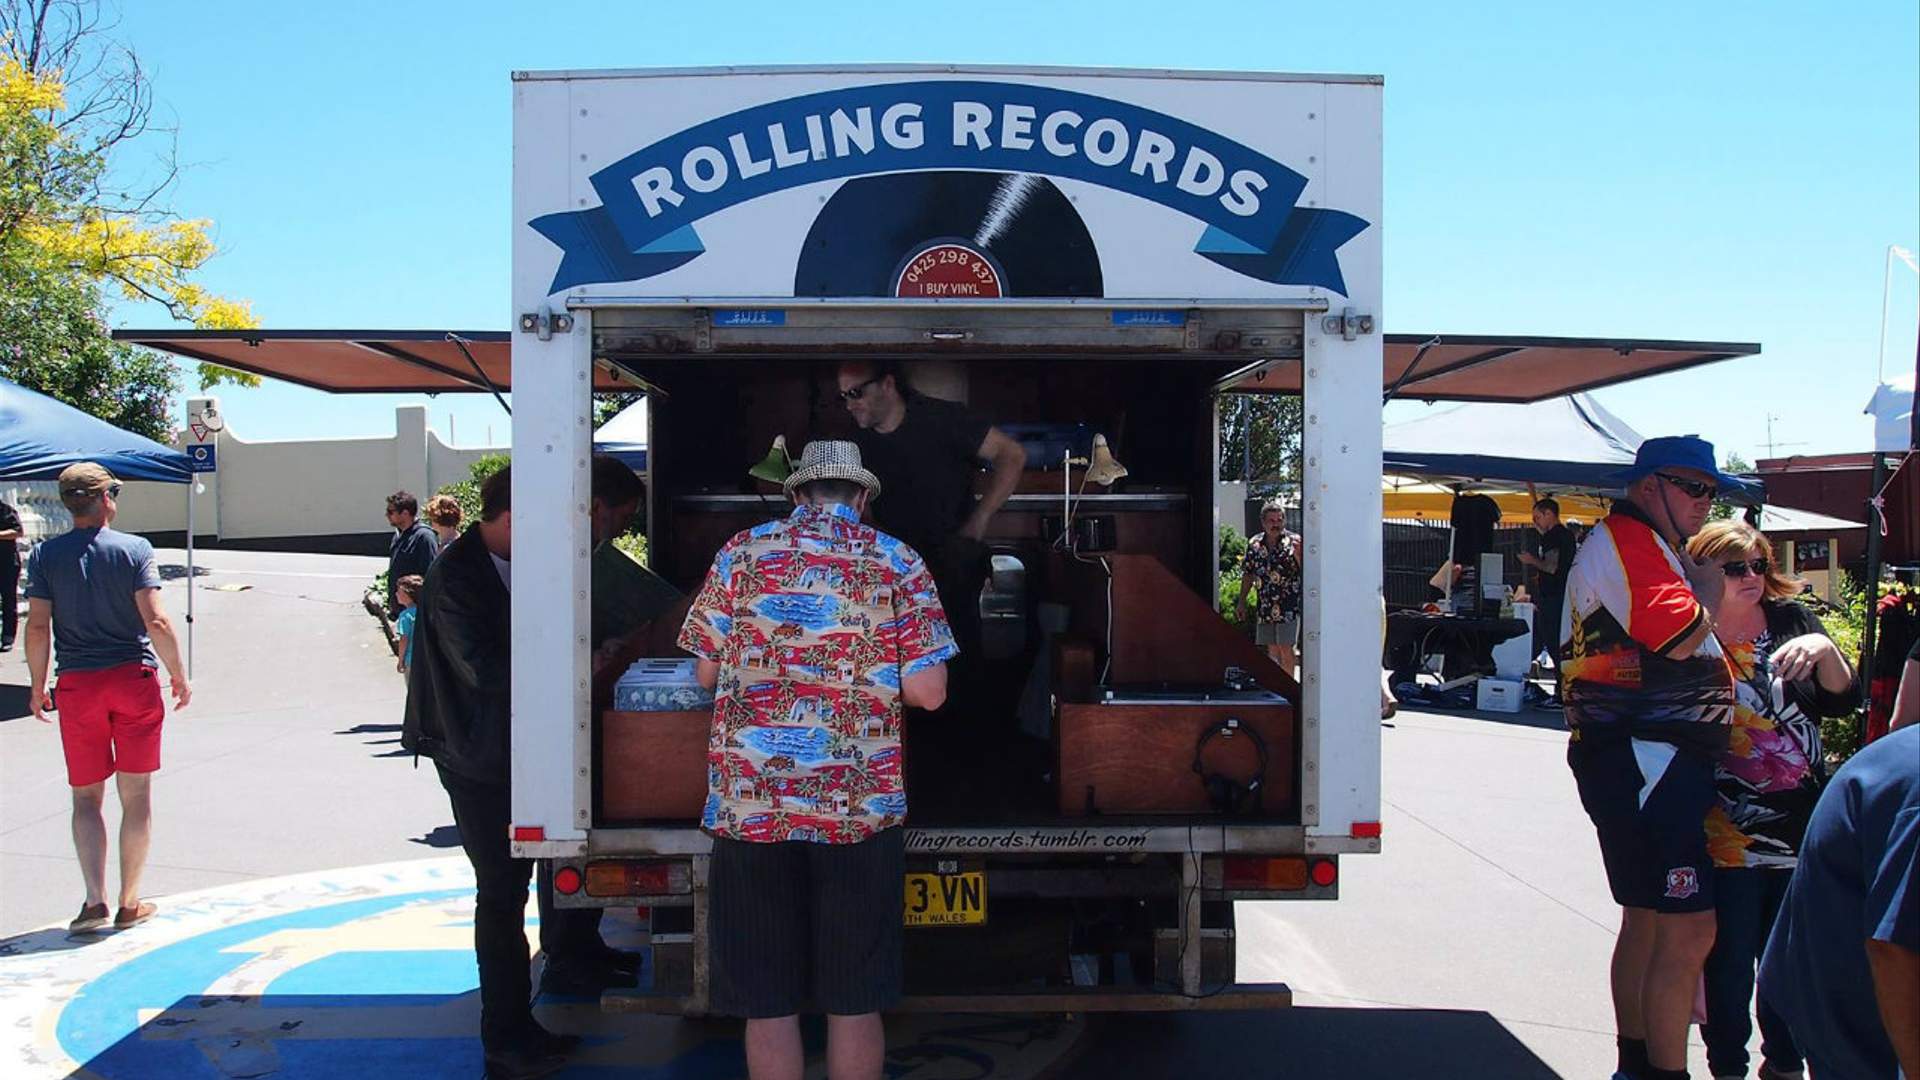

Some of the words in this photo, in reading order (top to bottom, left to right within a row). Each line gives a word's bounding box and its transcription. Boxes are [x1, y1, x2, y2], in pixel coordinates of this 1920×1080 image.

[631, 102, 925, 218] ROLLING
[953, 101, 1269, 217] RECORDS
[907, 254, 936, 283] 0425
[938, 250, 969, 266] 298
[971, 261, 994, 284] 437
[919, 284, 923, 295] I
[926, 282, 949, 295] BUY
[950, 283, 980, 295] VINYL
[903, 914, 922, 923] TH
[928, 913, 967, 923] WALES
